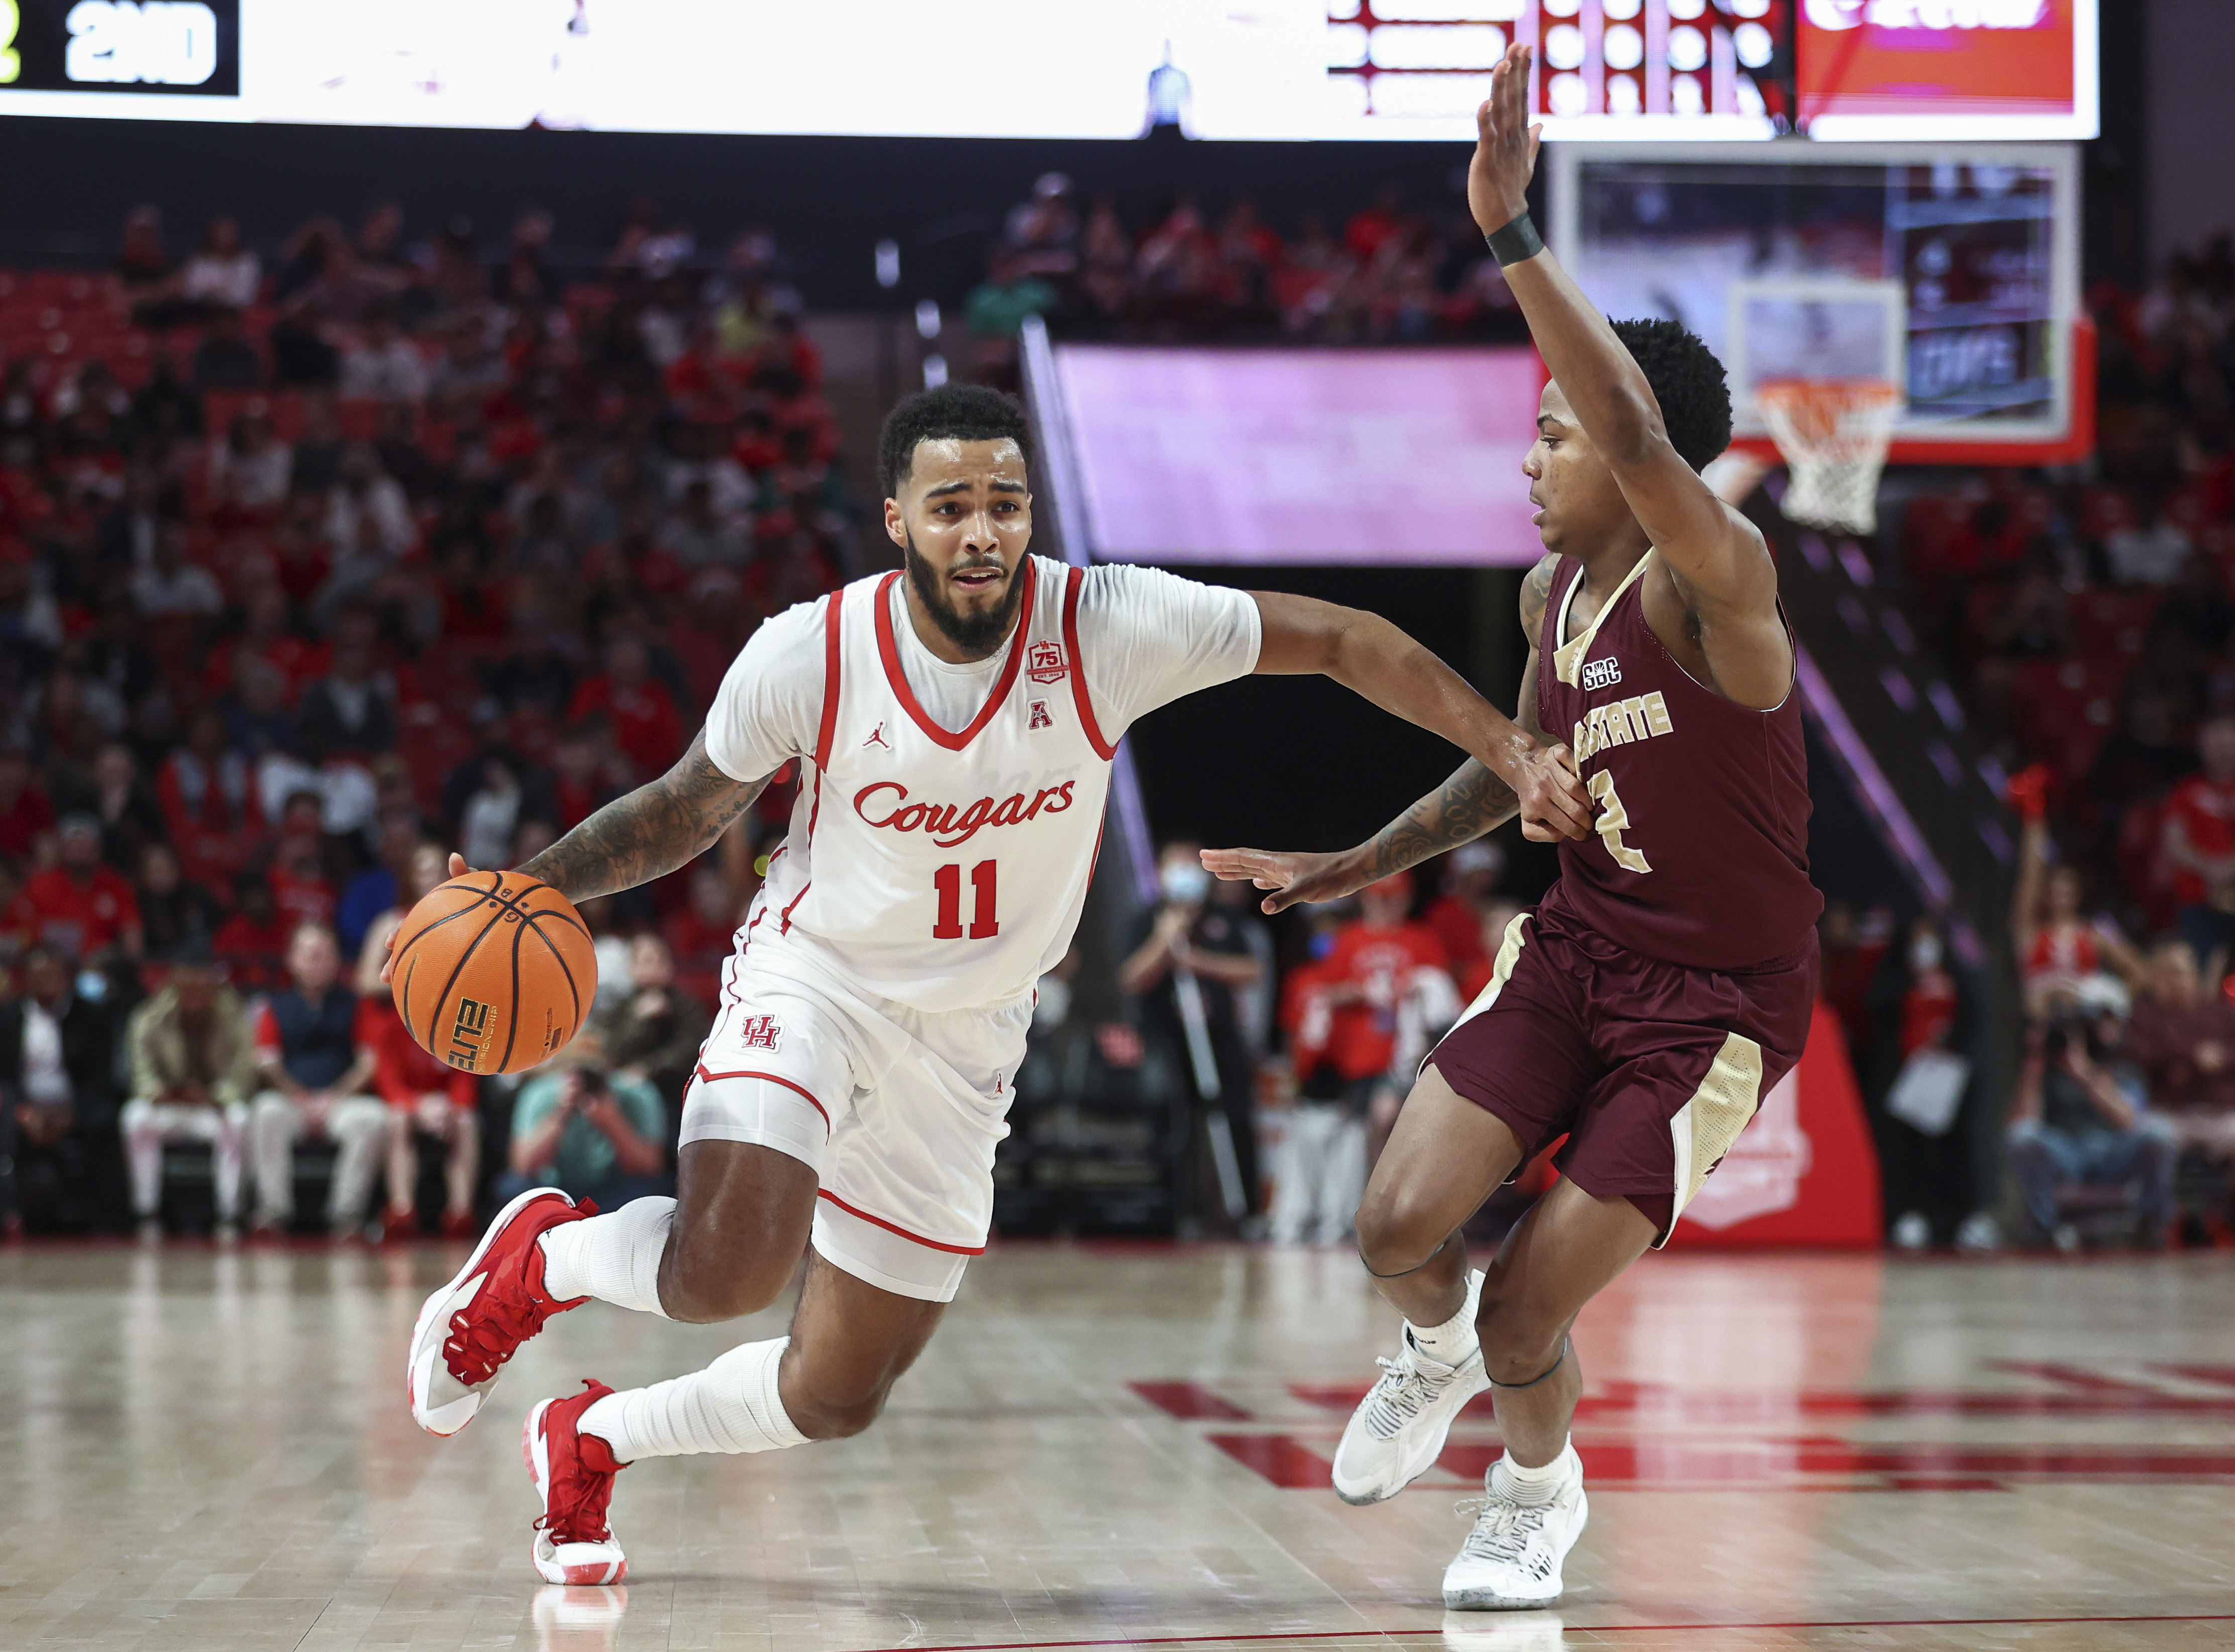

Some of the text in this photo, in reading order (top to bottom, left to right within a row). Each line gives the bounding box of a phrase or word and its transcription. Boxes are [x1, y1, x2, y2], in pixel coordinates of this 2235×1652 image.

[1035, 651, 1058, 667] 75
[1582, 656, 1622, 691] SBC
[853, 780, 1076, 848] Cougars
[932, 859, 999, 939] 11
